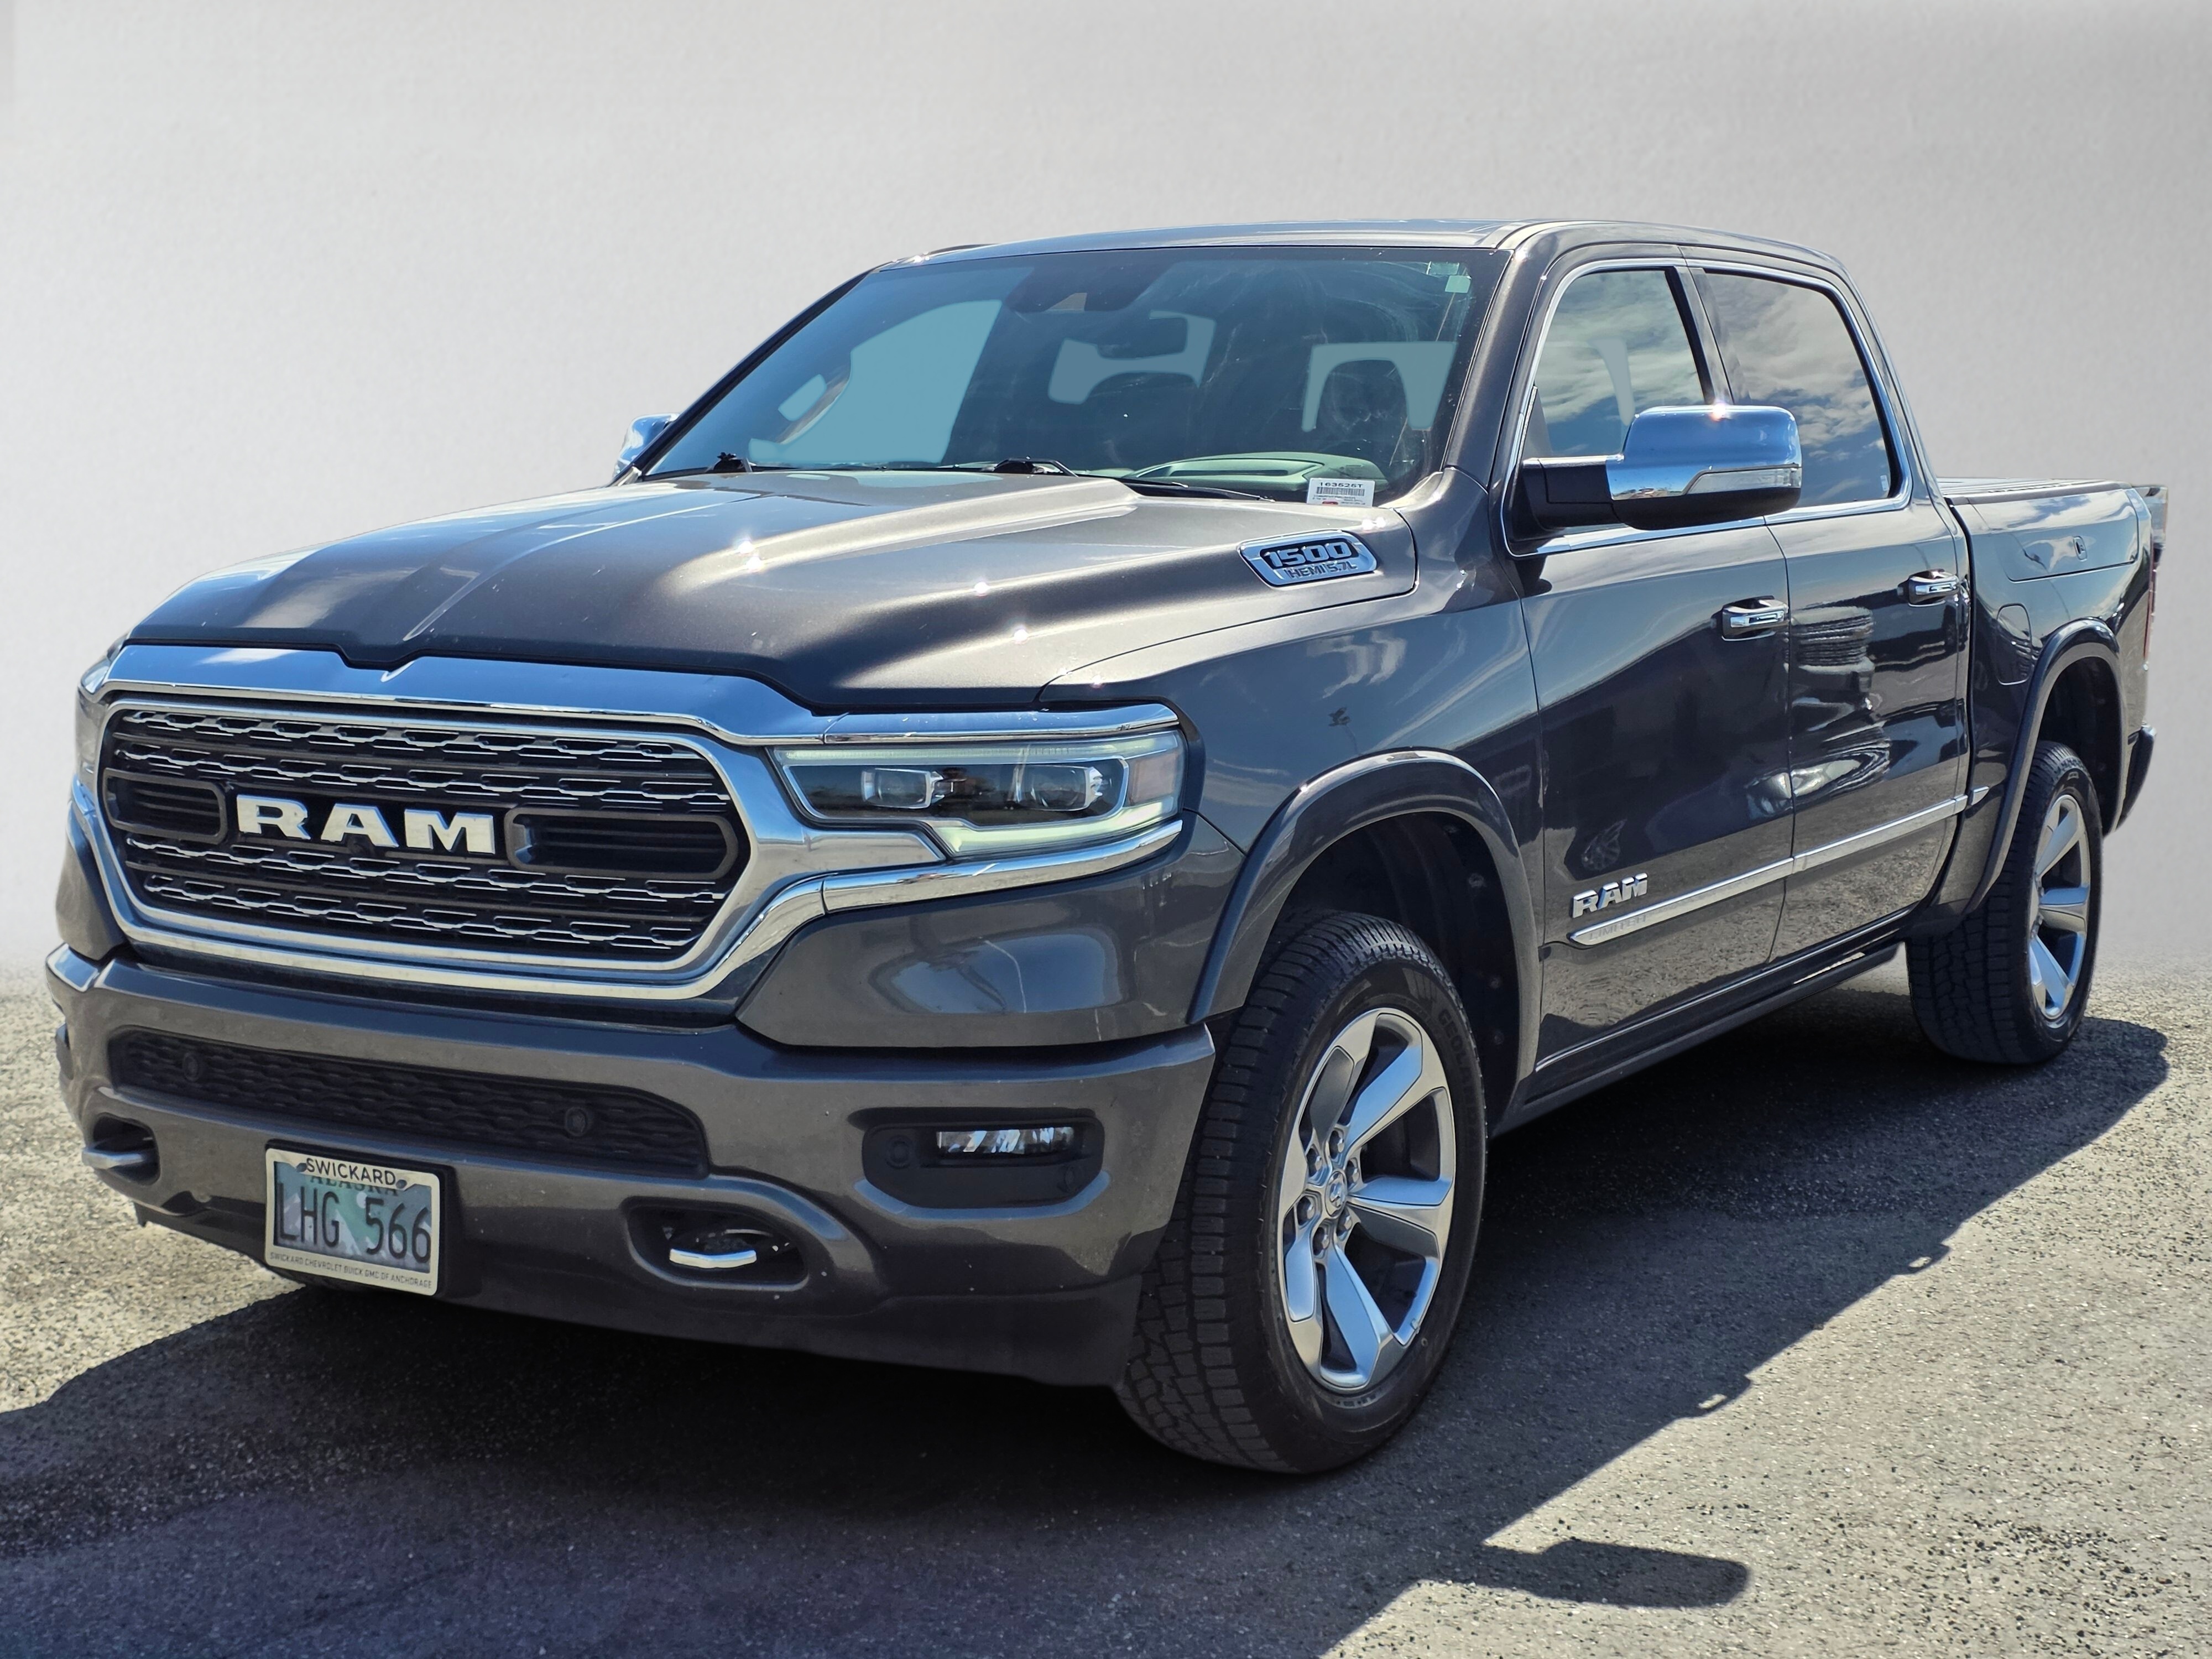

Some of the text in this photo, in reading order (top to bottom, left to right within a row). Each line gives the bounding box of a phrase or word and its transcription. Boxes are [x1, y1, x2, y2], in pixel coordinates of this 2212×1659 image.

[1264, 541, 1352, 567] 1500
[1288, 560, 1358, 578] HEMI 5.7L
[236, 794, 496, 854] RAM
[1572, 872, 1648, 919] RAM
[306, 1157, 396, 1186] SWICKARD
[278, 1182, 431, 1264] LHG 566
[270, 1252, 432, 1289] SWICKARD CHEVROLET BUICK GMC OF ANCHORAGE
